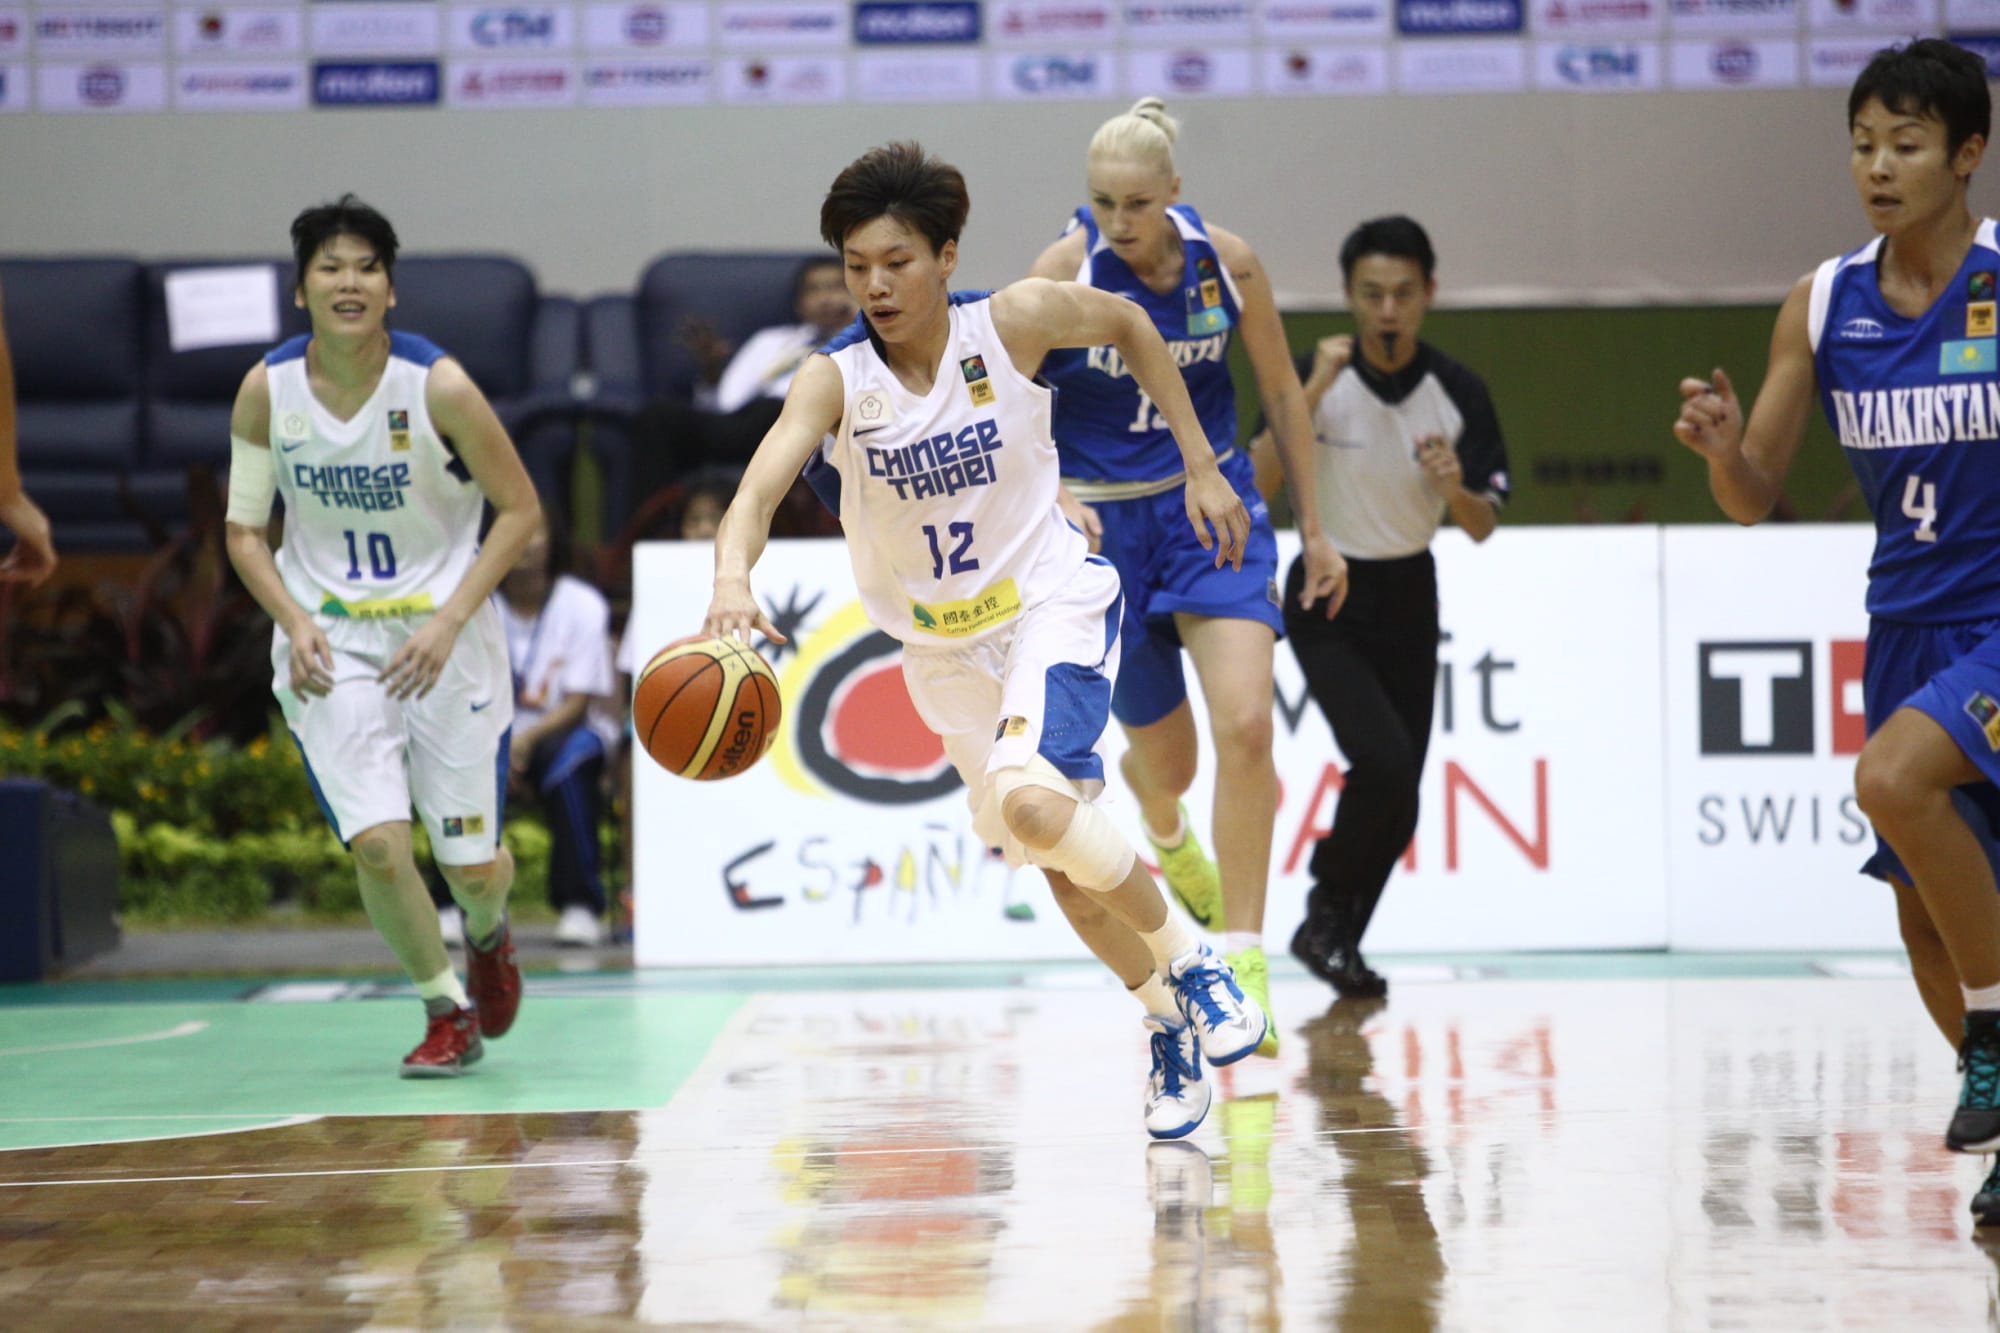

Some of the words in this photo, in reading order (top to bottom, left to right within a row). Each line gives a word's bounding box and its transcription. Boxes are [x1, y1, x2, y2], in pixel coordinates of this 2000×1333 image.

[1901, 474, 1938, 542] 4
[343, 530, 397, 580] 10
[922, 521, 980, 580] 12
